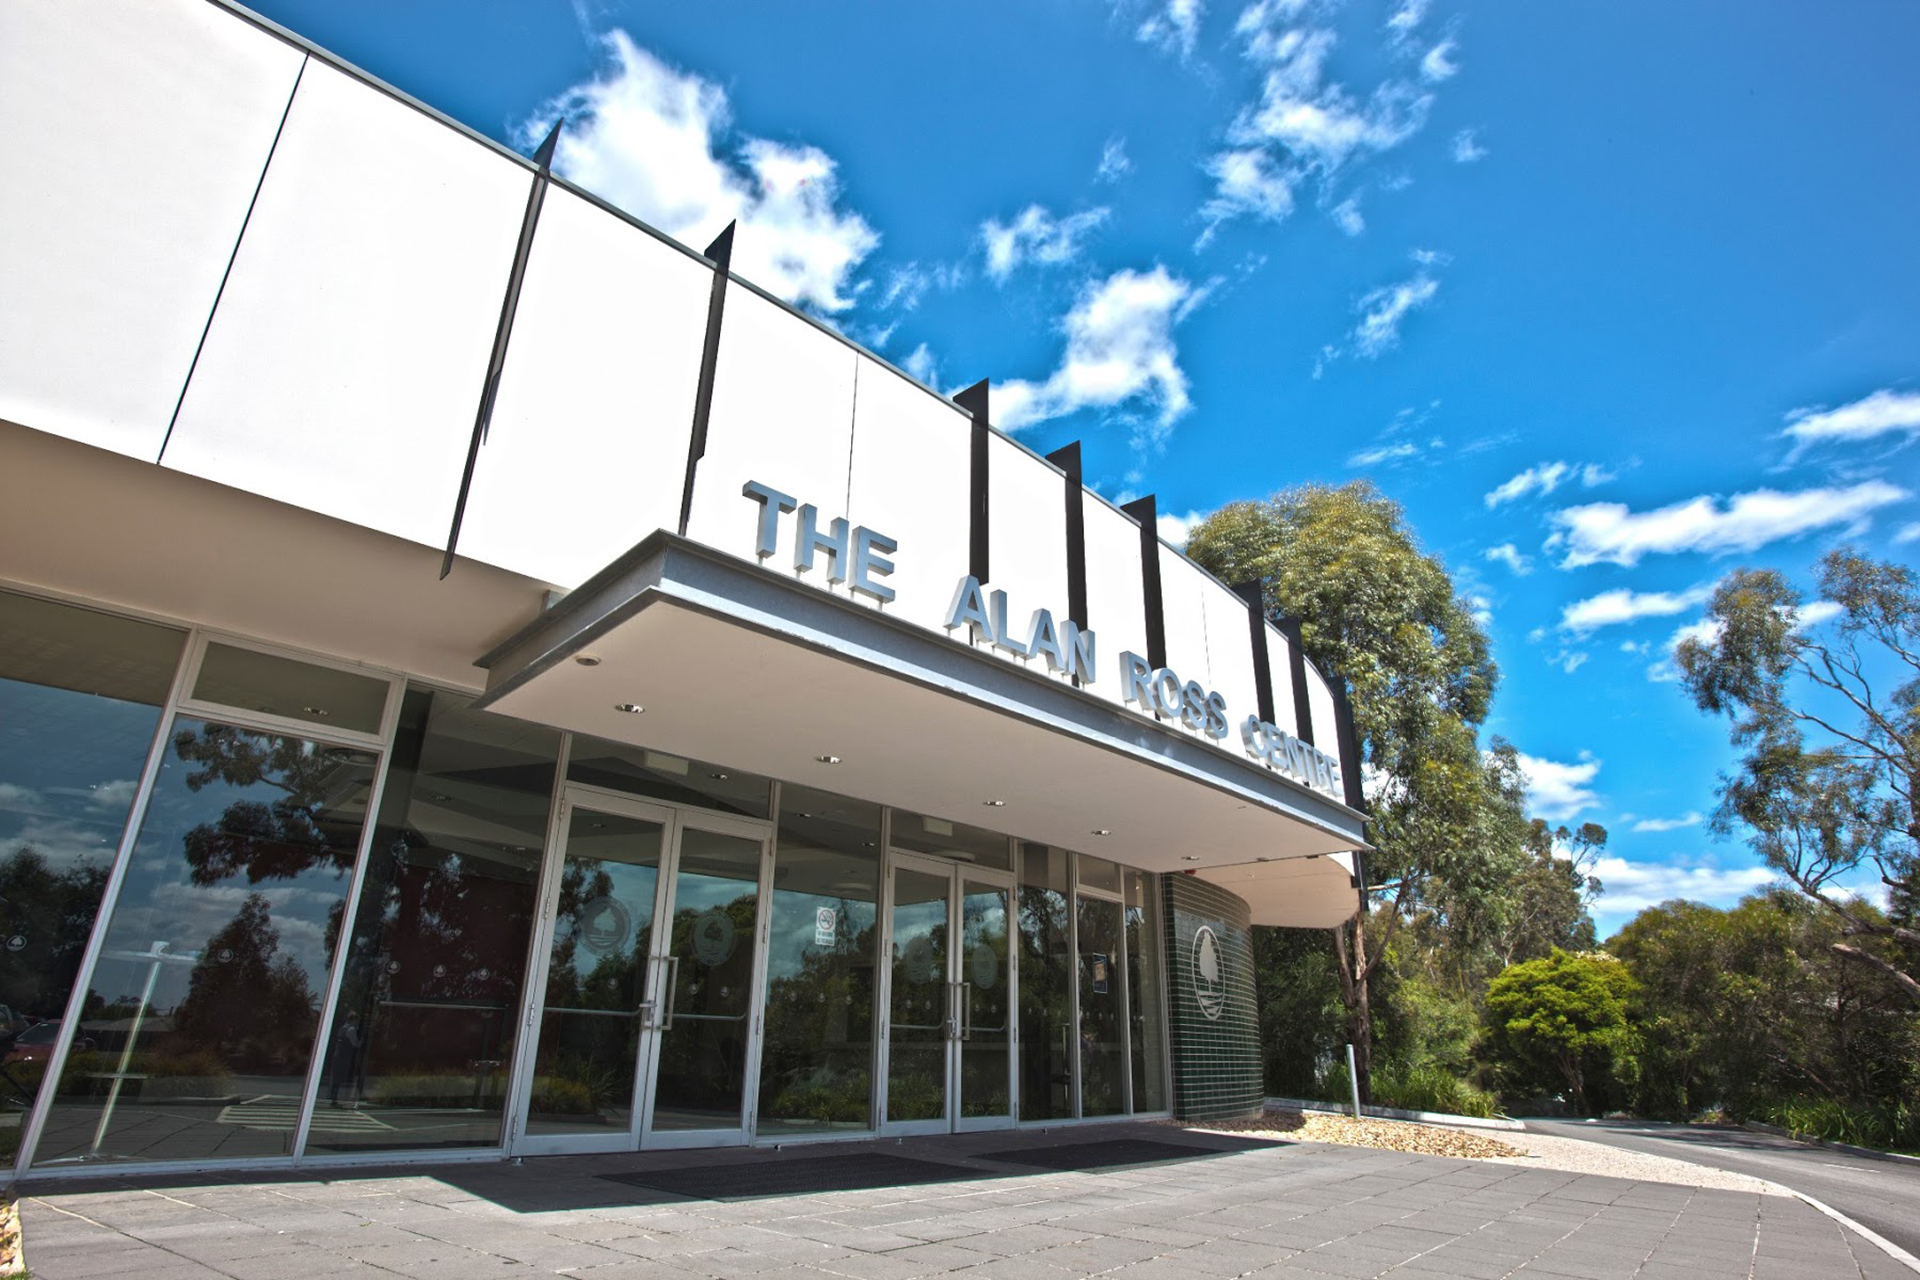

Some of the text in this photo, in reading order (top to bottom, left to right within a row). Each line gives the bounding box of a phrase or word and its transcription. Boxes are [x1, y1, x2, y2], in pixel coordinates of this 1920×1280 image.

[742, 480, 1344, 797] THE ALAN ROSS CENTRE
